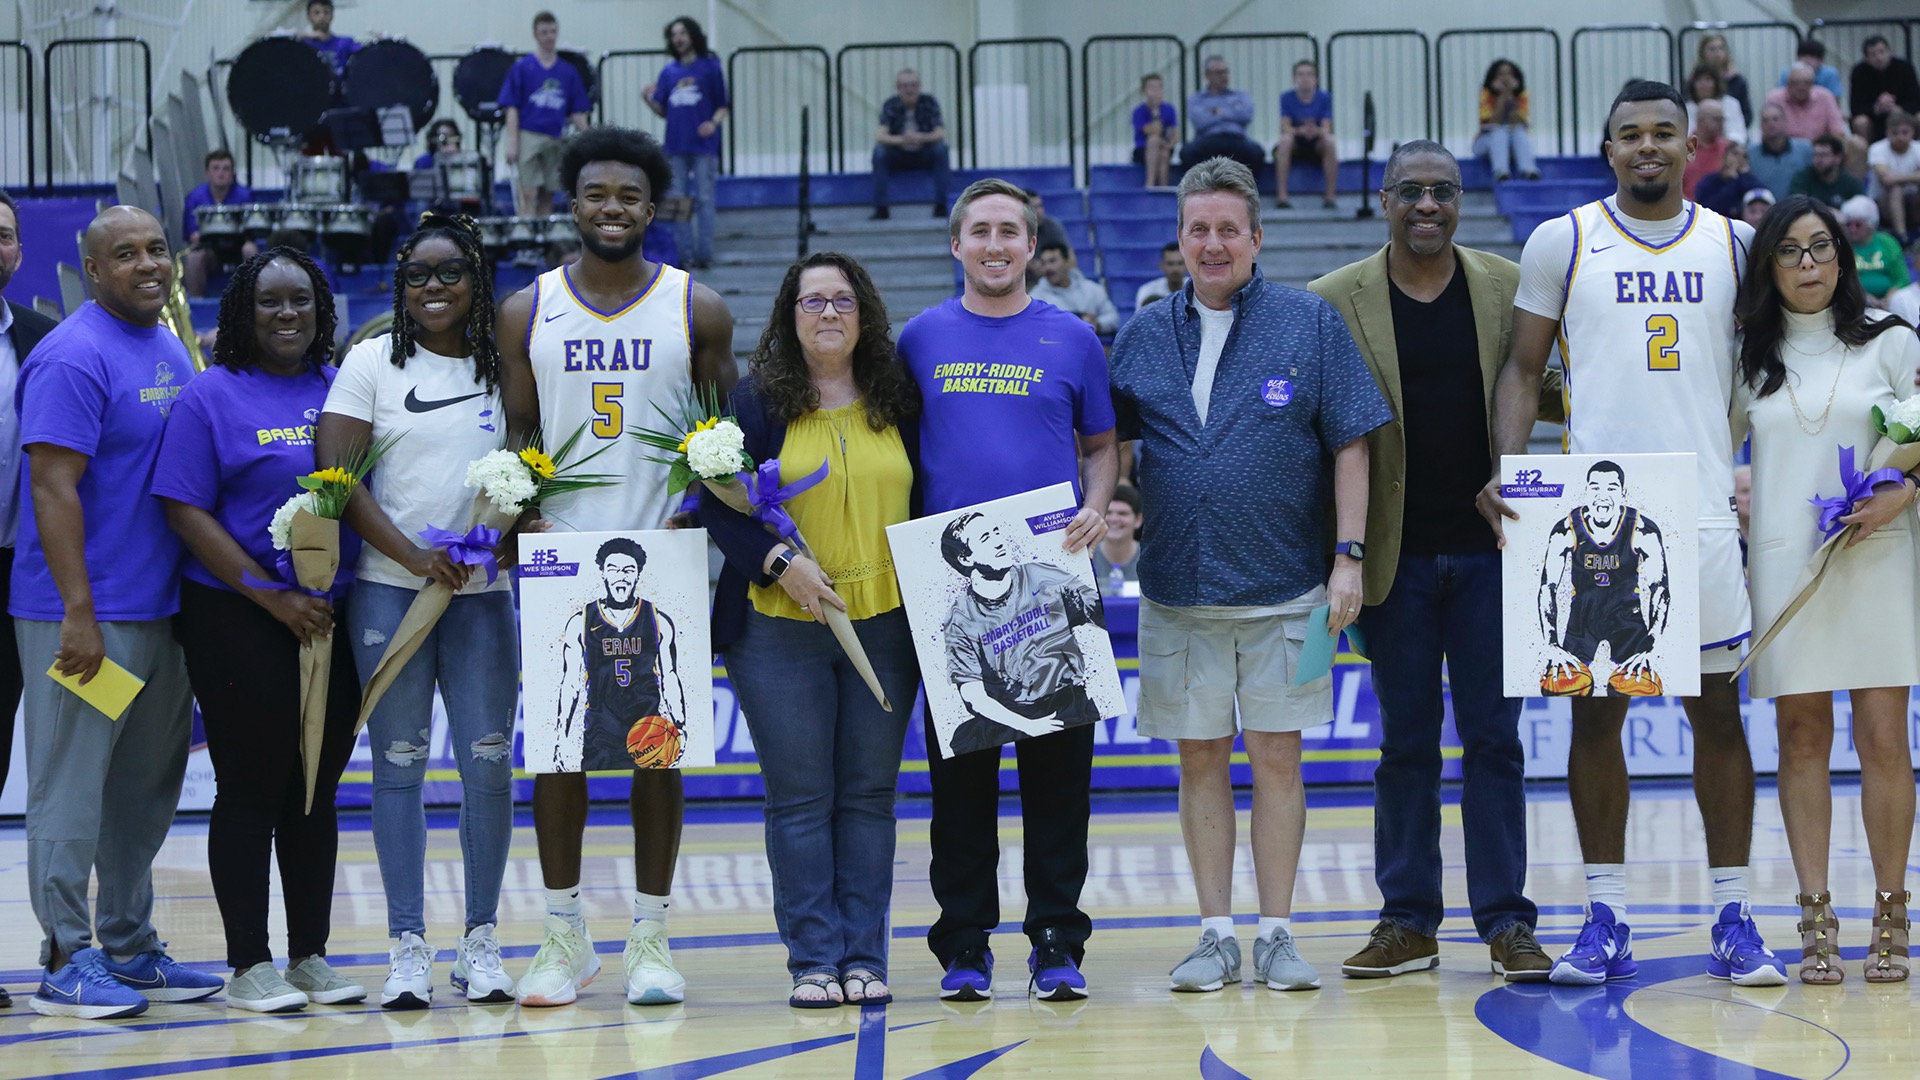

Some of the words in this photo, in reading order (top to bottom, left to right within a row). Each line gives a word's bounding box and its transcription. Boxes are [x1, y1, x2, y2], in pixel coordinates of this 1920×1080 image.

[1614, 270, 1704, 304] ERAU
[1645, 313, 1681, 372] 2
[563, 338, 653, 373] ERAU
[933, 362, 1045, 383] EMBRY-RIDDLE
[942, 377, 1029, 396] BASKETBALL
[591, 382, 624, 440] 5
[1515, 469, 1543, 485] #2
[1043, 511, 1066, 522] AVERY
[531, 549, 559, 565] #5
[1584, 553, 1620, 570] ERAU
[1594, 572, 1611, 586] 2
[981, 603, 1051, 646] EMBRY-RIDDLE
[602, 637, 642, 655] ERAU
[992, 618, 1052, 655] BASKETBALL
[614, 659, 632, 687] 5
